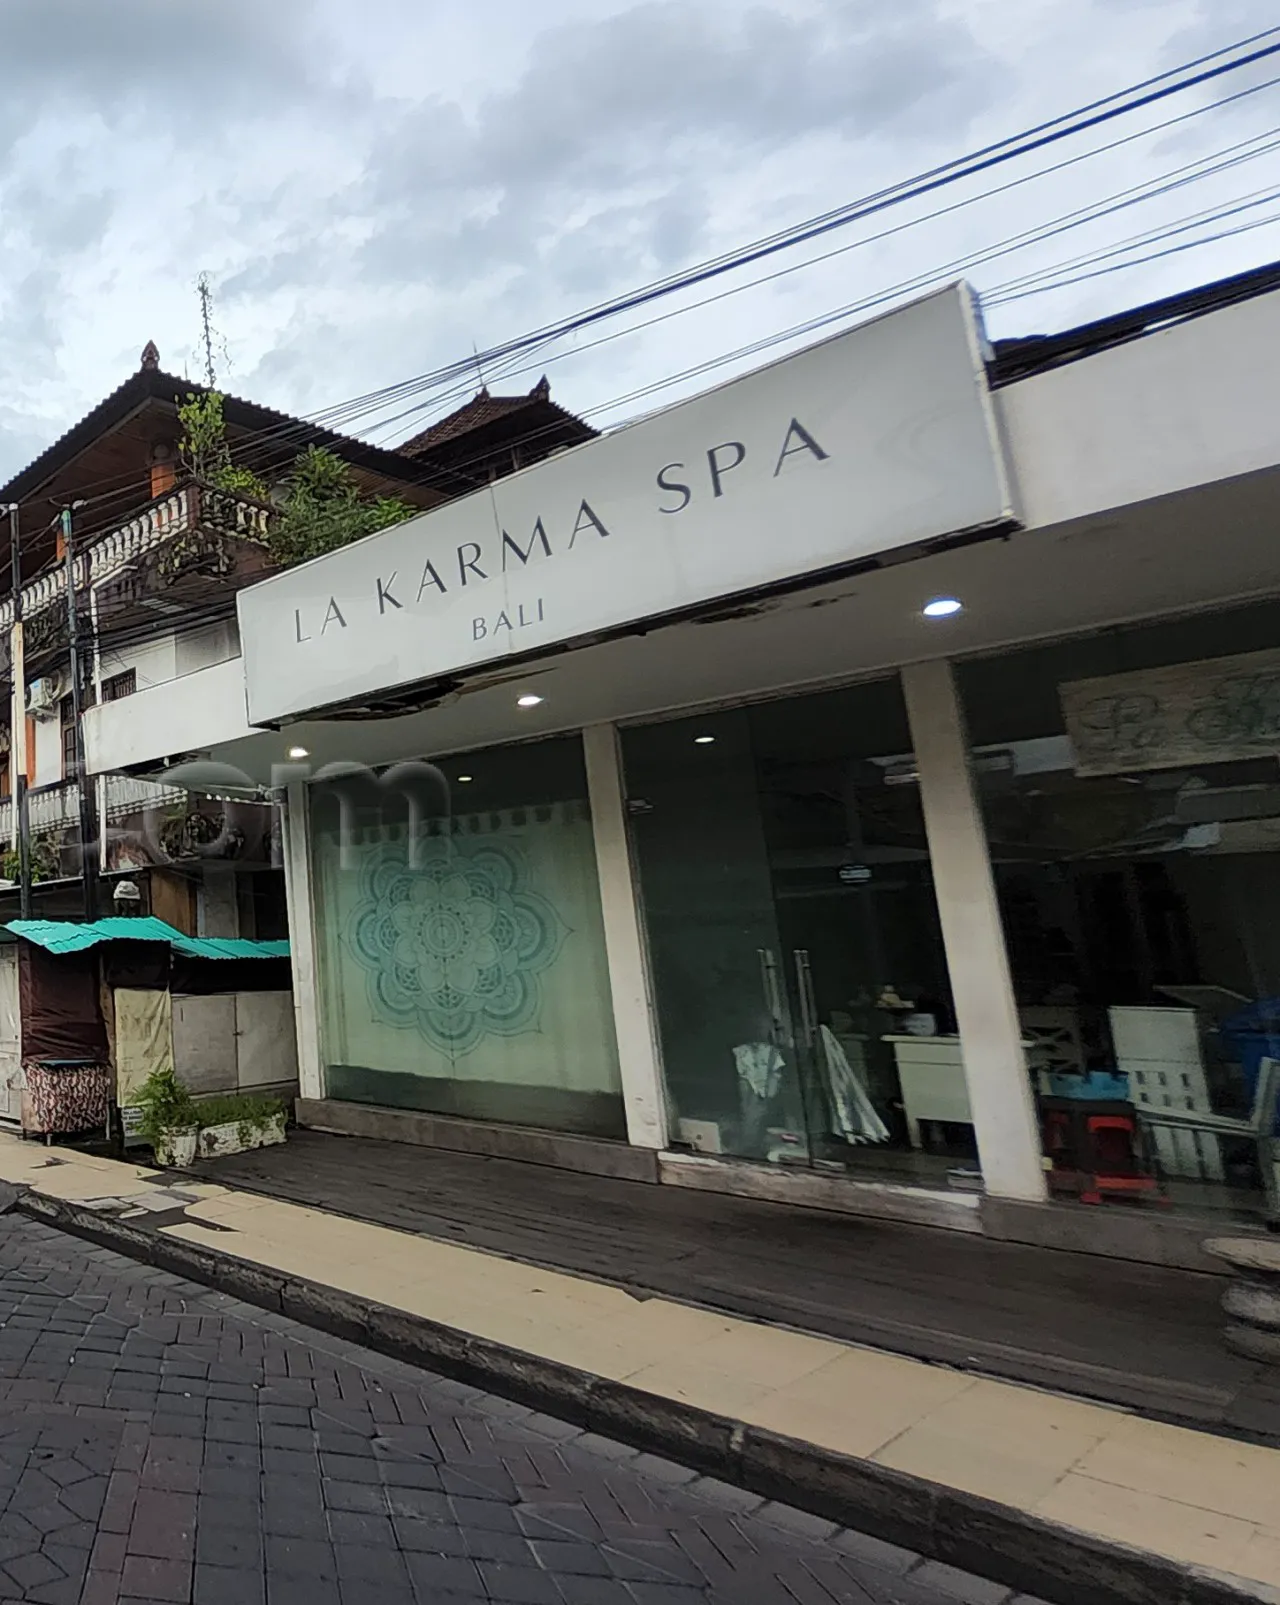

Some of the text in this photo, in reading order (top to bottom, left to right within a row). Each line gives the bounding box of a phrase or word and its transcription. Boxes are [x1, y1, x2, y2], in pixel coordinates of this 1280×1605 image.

[294, 417, 832, 643] LA KARMA SPA
[472, 598, 545, 641] BALI
